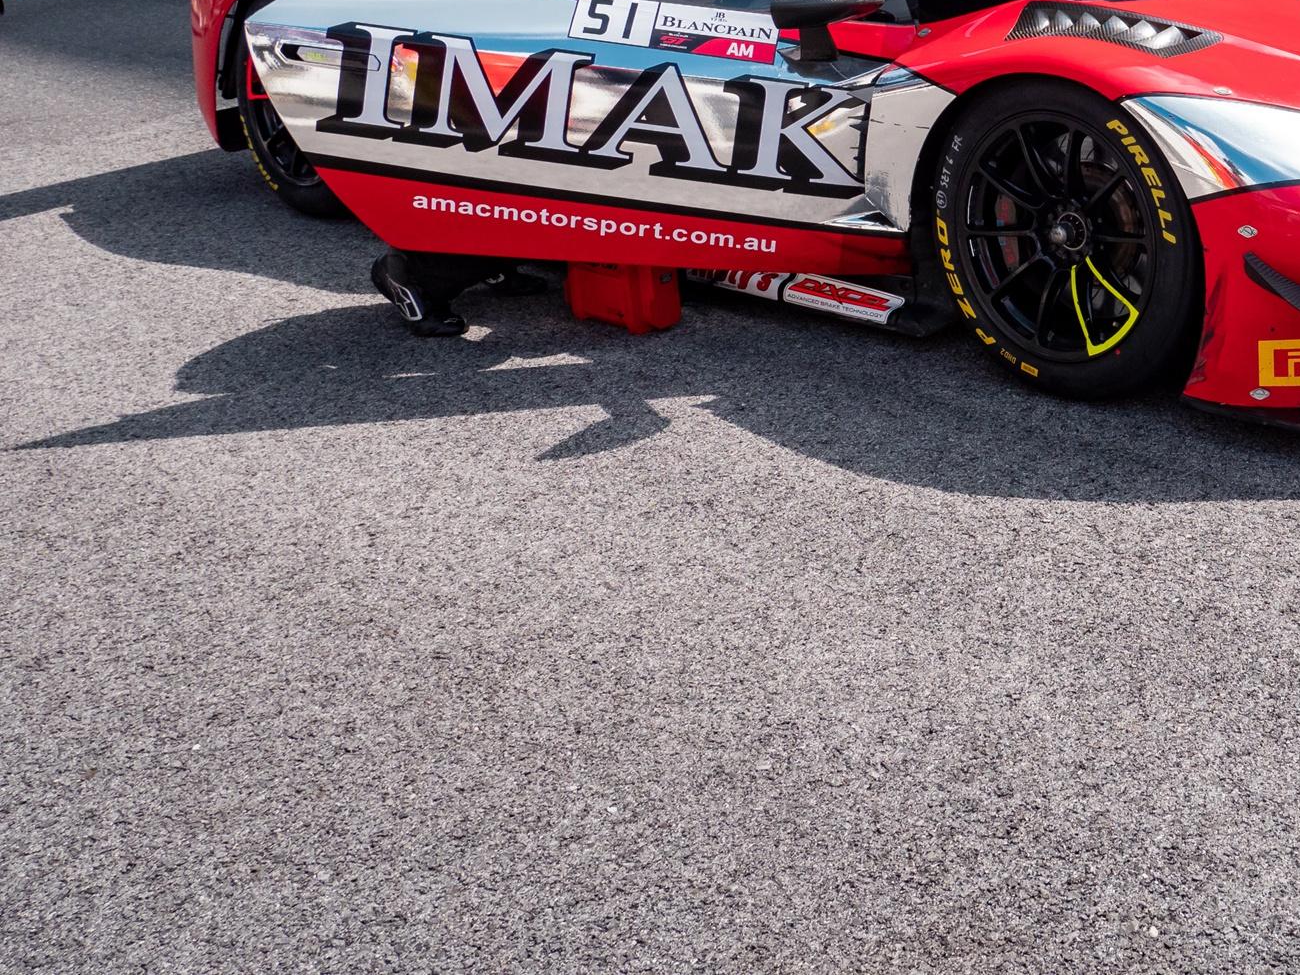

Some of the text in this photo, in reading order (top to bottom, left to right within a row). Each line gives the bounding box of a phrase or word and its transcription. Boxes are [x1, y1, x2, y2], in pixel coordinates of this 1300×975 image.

[661, 15, 773, 40] BLANCPAIN
[726, 42, 754, 58] AM
[316, 22, 866, 197] IMAK
[1107, 119, 1177, 244] PIRELLI
[412, 191, 777, 253] amacmotorsport.com.au
[789, 277, 891, 312] DIXCEL
[936, 216, 997, 345] P ZERO
[787, 293, 884, 319] ADVANCED BRAKE TECHNOLOGY
